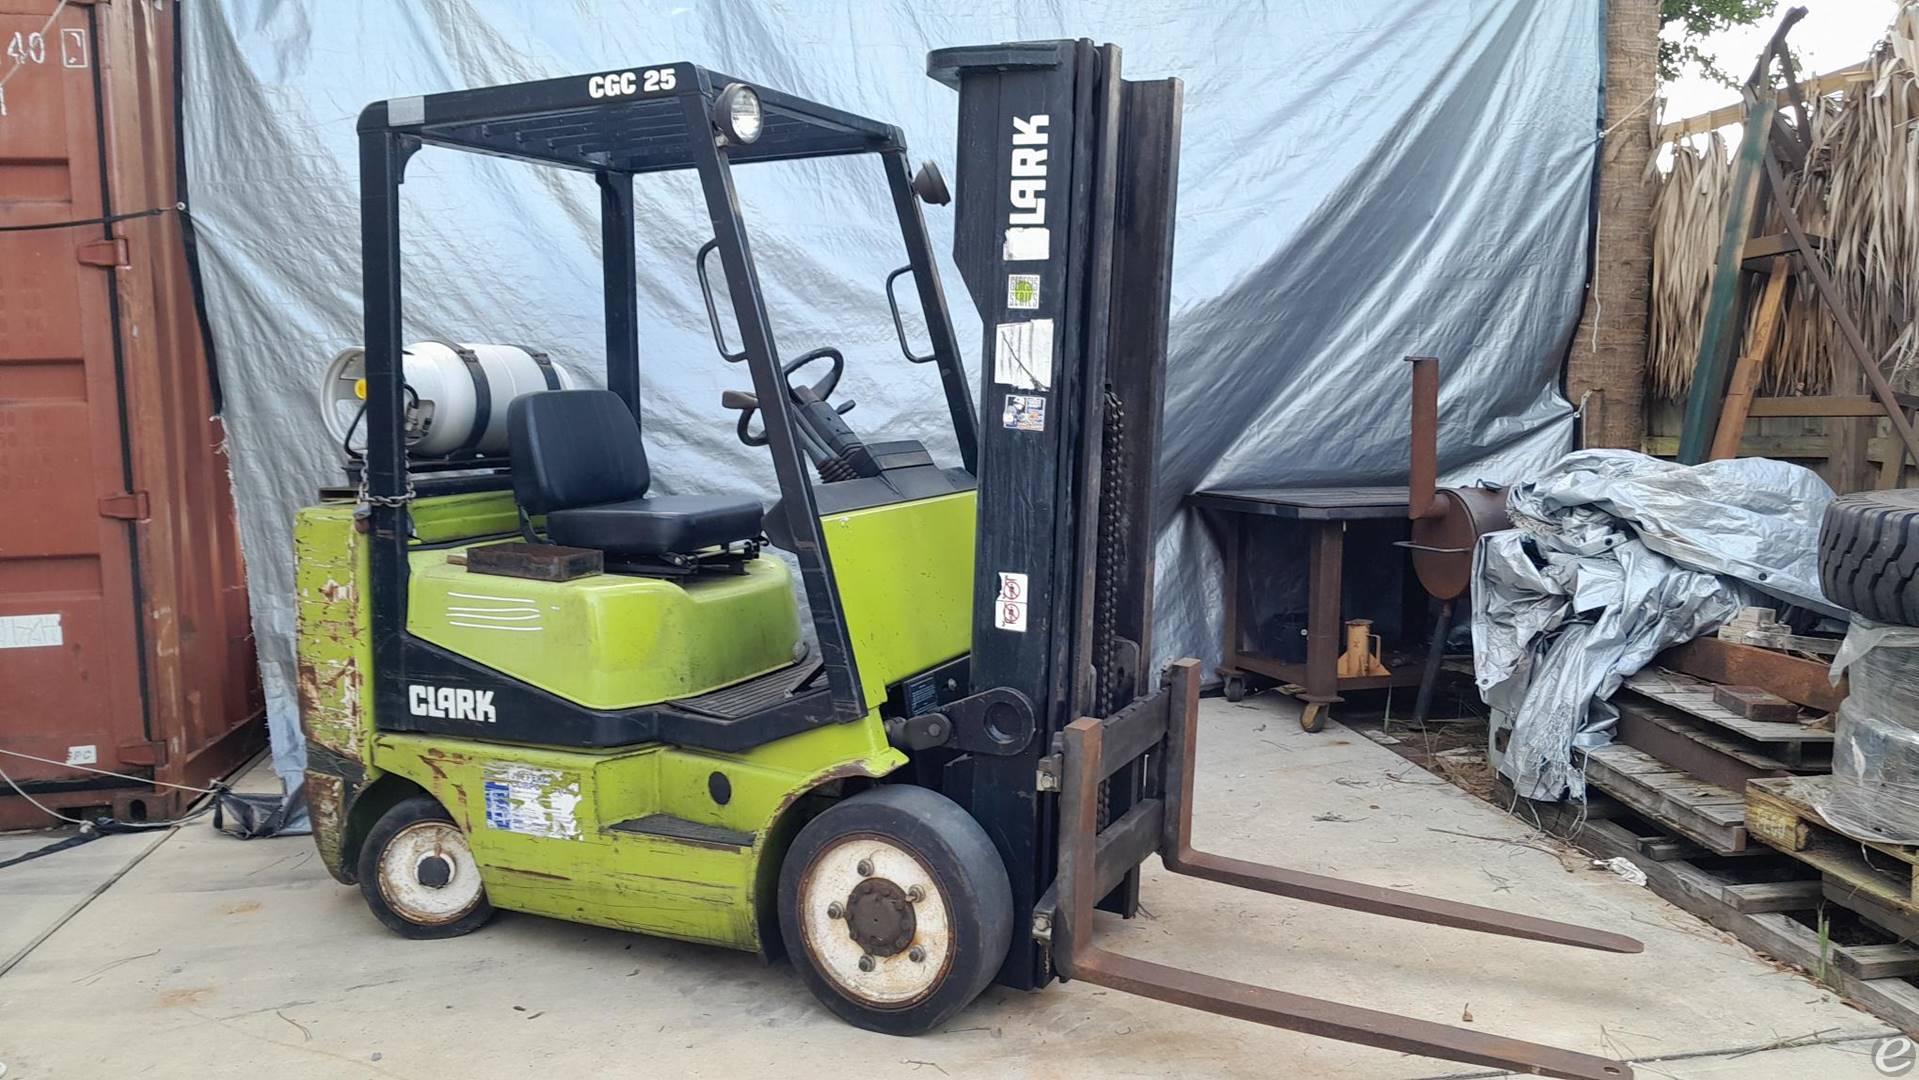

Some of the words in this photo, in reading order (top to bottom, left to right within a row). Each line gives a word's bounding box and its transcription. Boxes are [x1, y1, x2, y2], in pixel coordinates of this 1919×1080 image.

[588, 72, 637, 99] CGC
[643, 68, 677, 92] 25
[1008, 114, 1050, 260] LARK
[408, 684, 497, 723] CLARK
